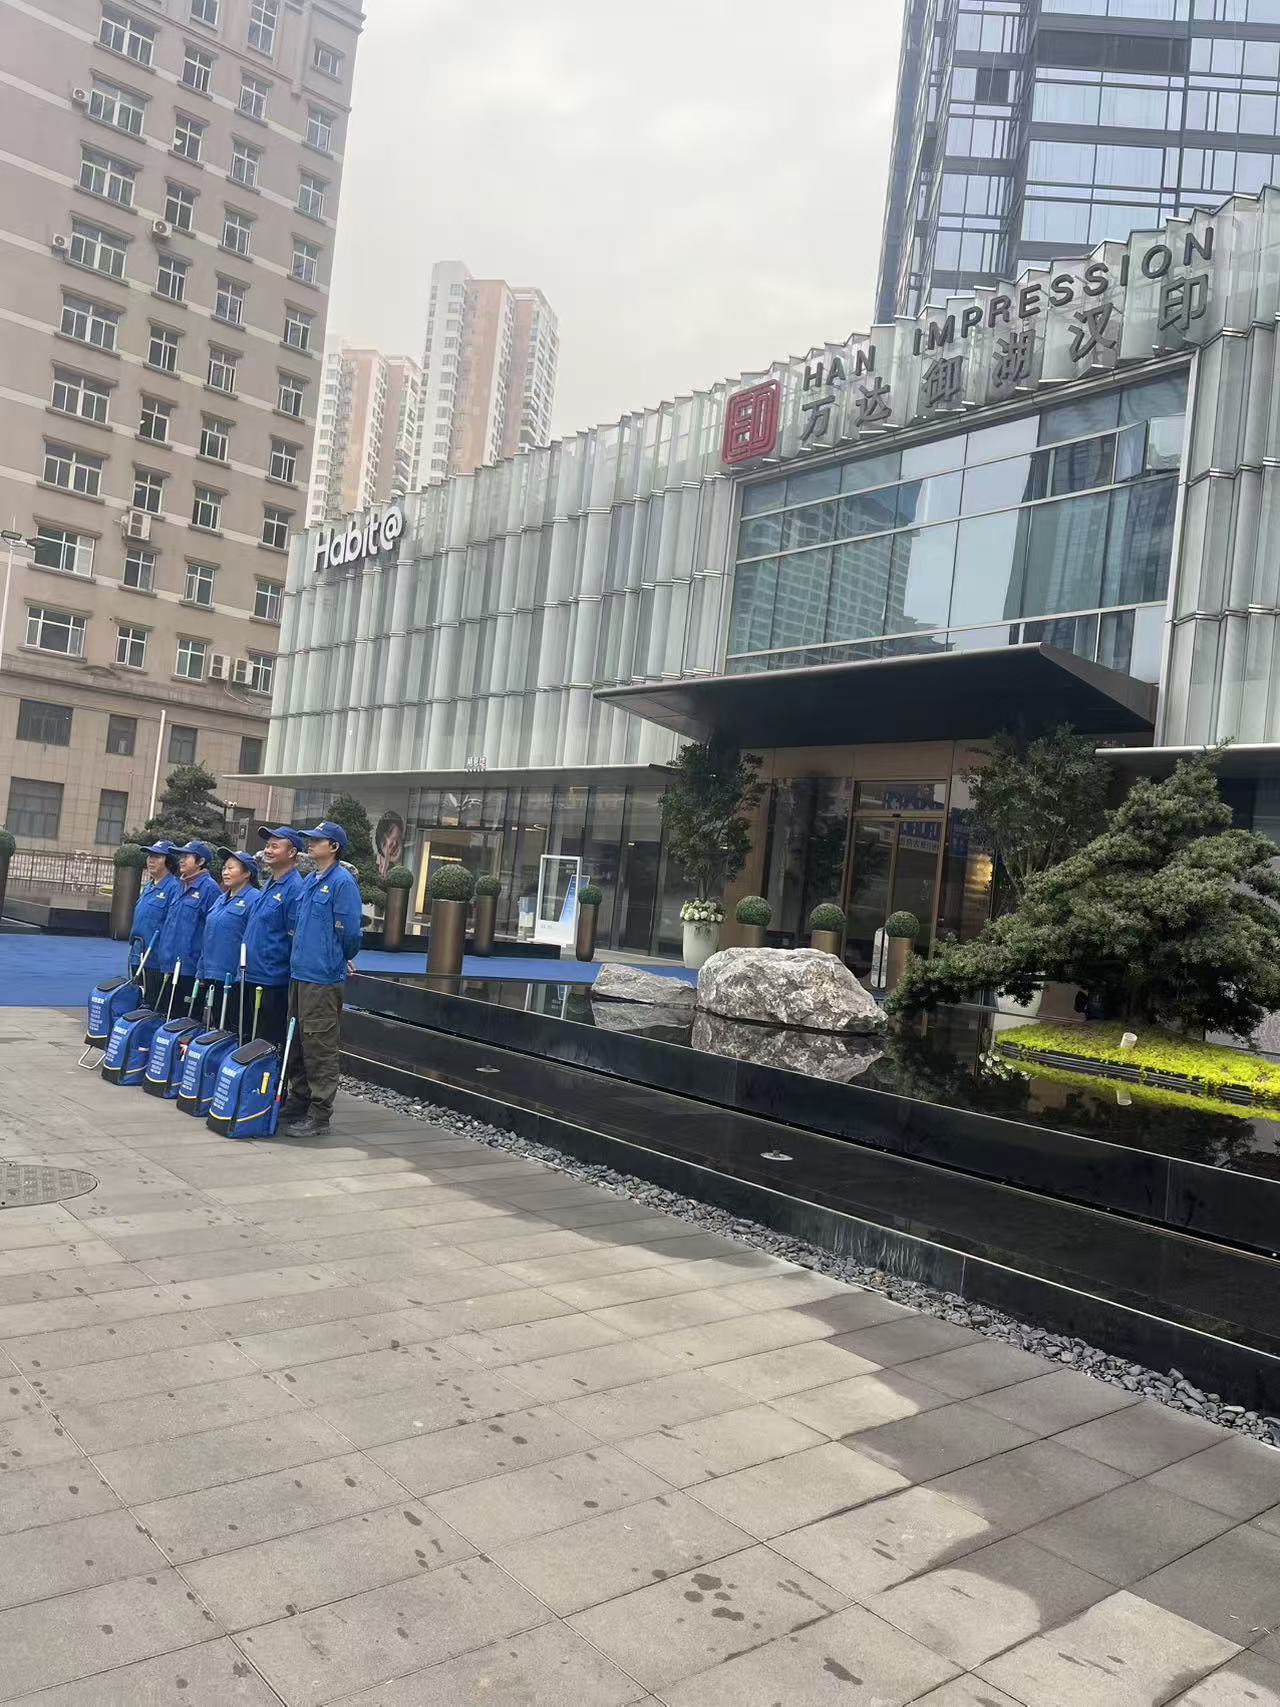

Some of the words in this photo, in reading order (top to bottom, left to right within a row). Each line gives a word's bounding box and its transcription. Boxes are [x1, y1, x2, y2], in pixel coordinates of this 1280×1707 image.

[800, 273, 1208, 441] 万达御湖汉印
[803, 344, 876, 391] HAN
[913, 226, 1214, 356] IMPRESSION
[312, 505, 403, 572] Habit@
